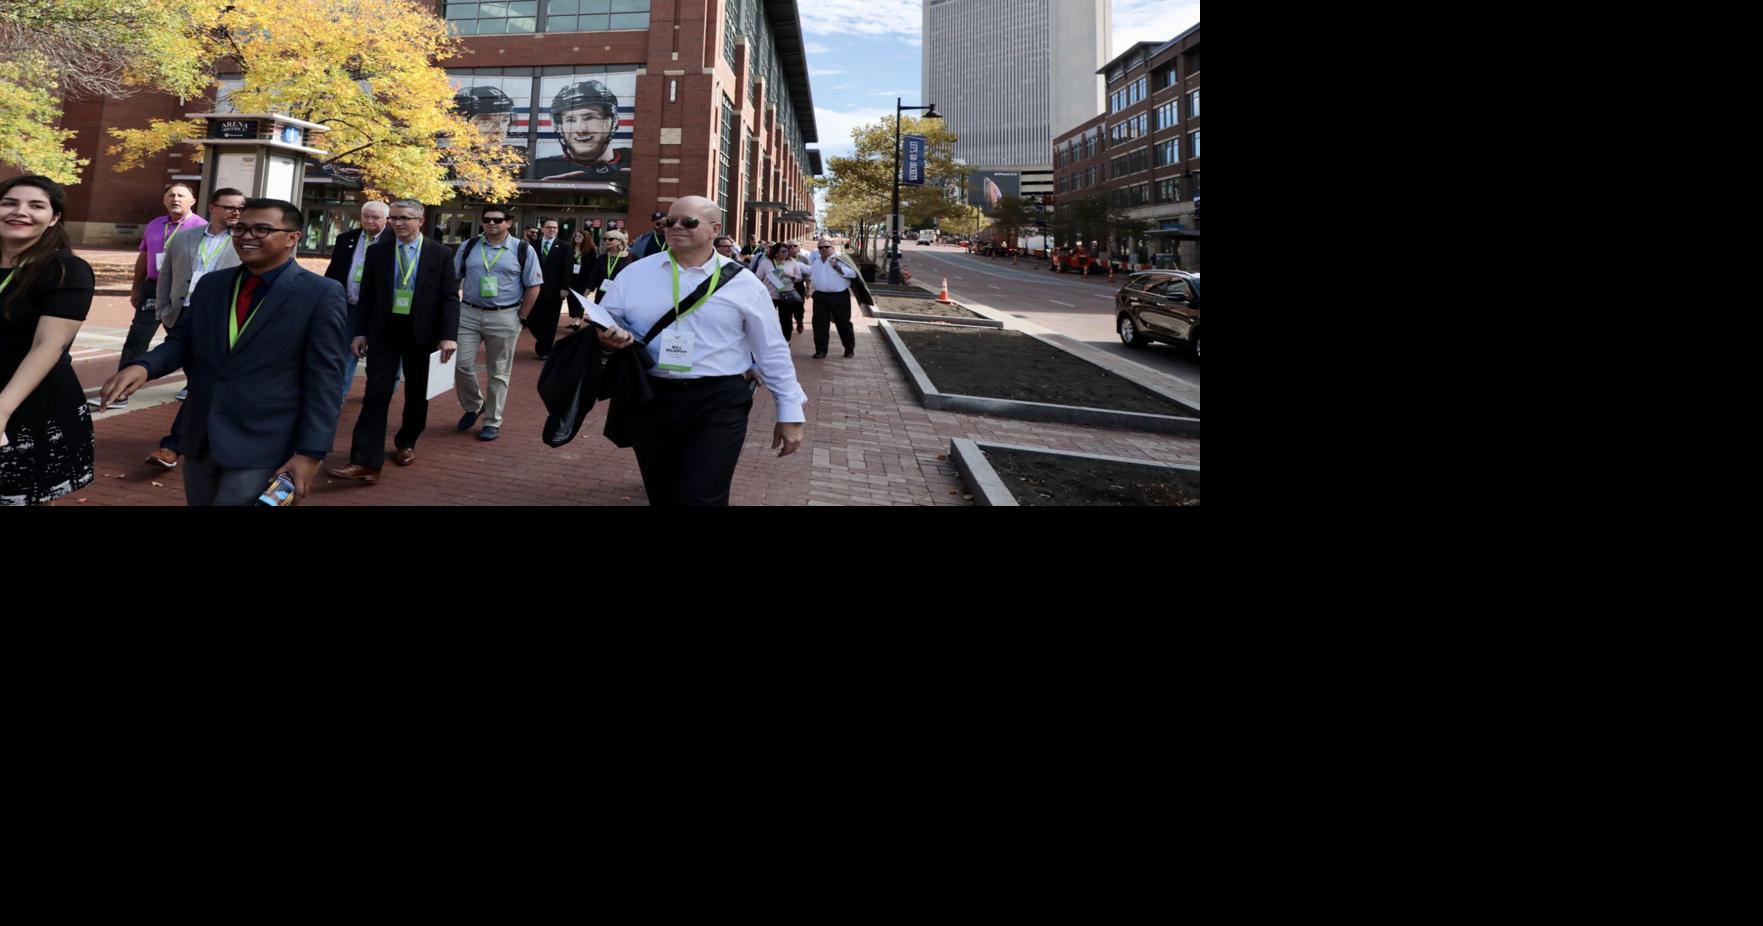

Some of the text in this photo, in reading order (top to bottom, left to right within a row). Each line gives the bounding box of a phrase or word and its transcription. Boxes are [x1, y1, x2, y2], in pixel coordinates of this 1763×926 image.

[222, 121, 248, 129] ARENA
[909, 141, 918, 153] LET'S
[909, 161, 918, 181] JACKETS
